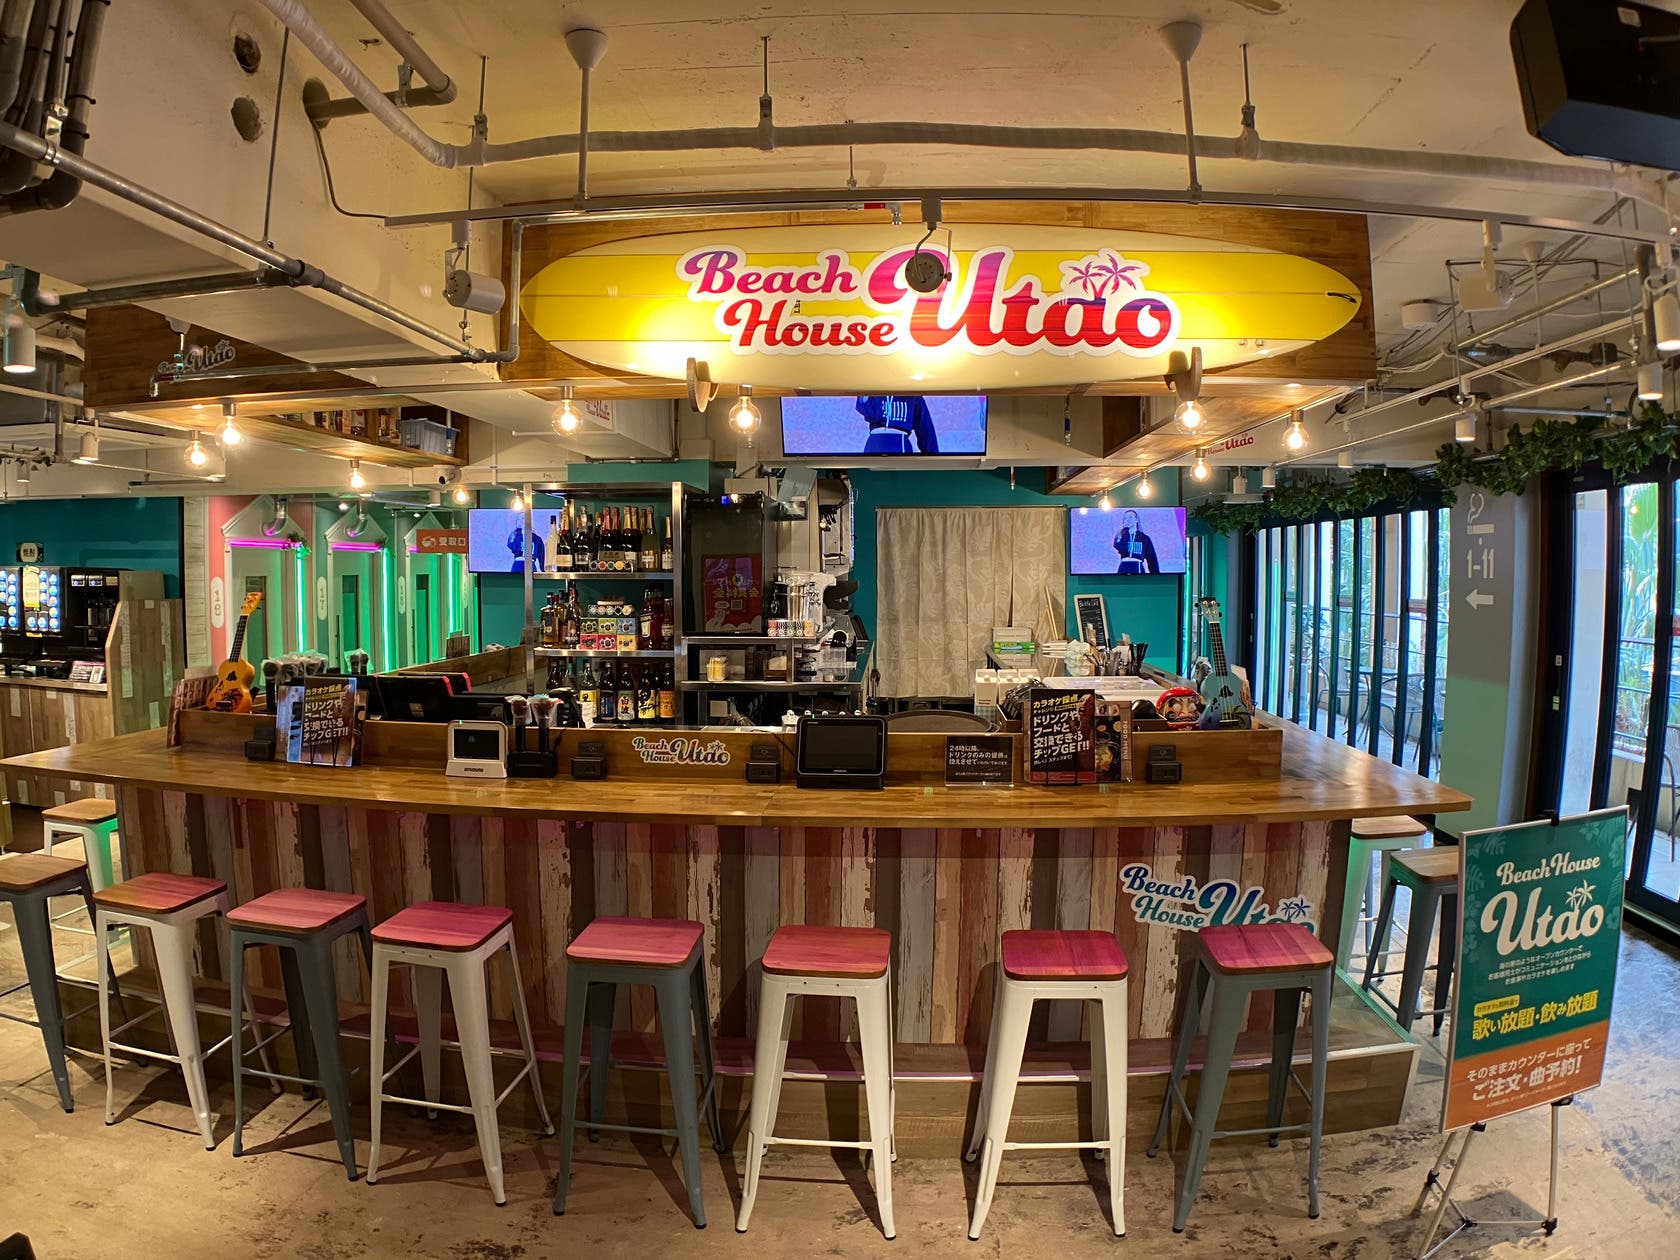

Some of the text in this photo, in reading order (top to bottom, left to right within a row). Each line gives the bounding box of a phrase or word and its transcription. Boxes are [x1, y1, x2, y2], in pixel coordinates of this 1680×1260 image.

[686, 250, 858, 295] Beach
[868, 248, 1174, 348] Utao
[723, 298, 899, 348] House
[1224, 436, 1254, 450] Utao
[438, 536, 467, 547] 受取口
[1466, 547, 1495, 580] 1-11
[305, 699, 342, 713] ドリンクや
[1033, 710, 1080, 727] ドリンクや
[633, 737, 668, 750] Beach
[1033, 722, 1070, 738] フードと
[642, 750, 677, 762] House
[669, 739, 729, 764] Utao
[1124, 866, 1196, 901] Beach
[1496, 851, 1600, 886] Beach House
[1136, 895, 1206, 929] House
[1199, 882, 1315, 934] Ut
[1480, 886, 1604, 956] Utao
[1472, 990, 1599, 1040] 歌い放題・飲み放題
[1467, 1038, 1592, 1082] そのままカウンターに座って
